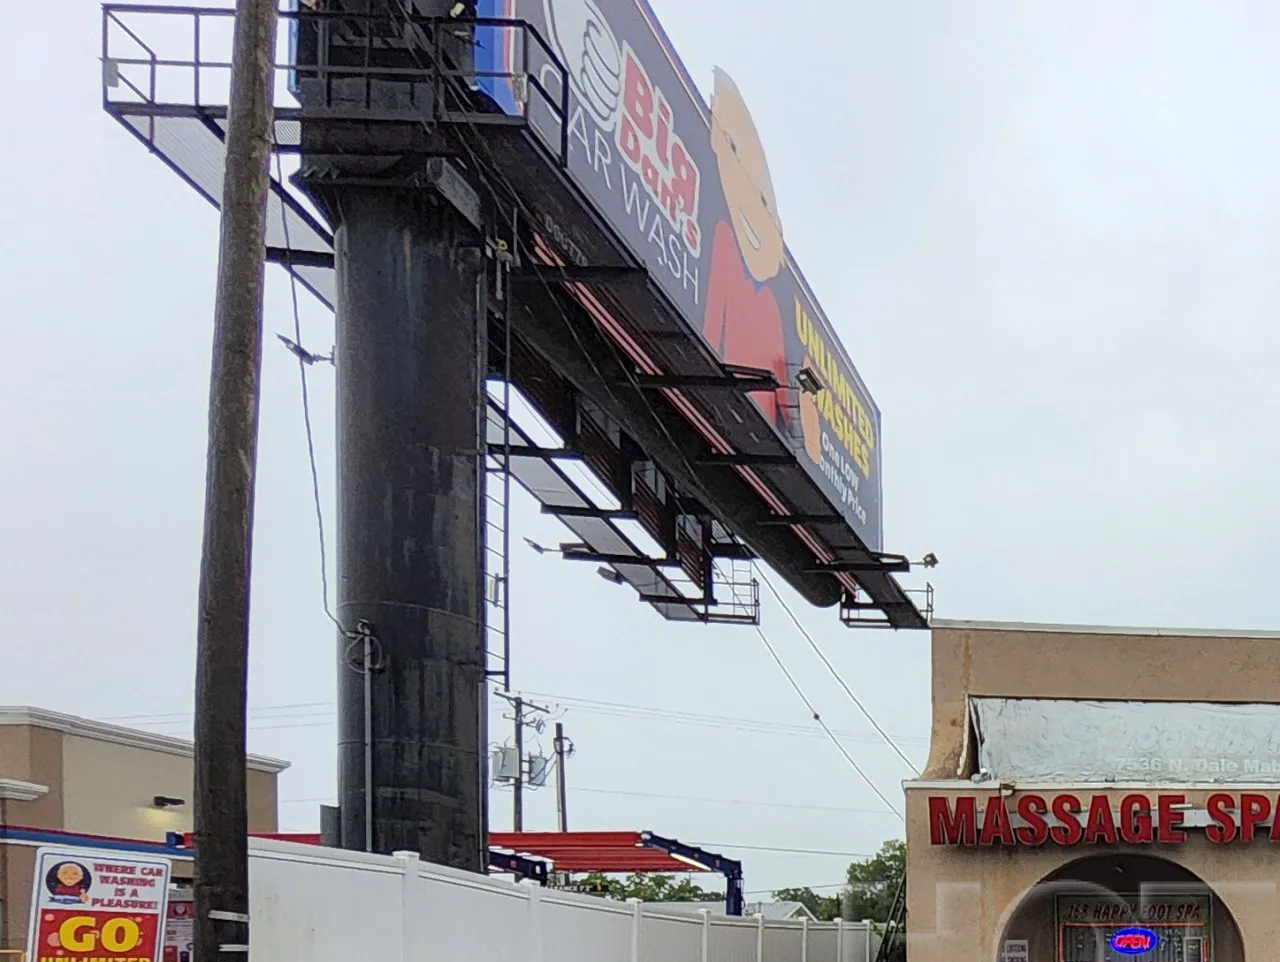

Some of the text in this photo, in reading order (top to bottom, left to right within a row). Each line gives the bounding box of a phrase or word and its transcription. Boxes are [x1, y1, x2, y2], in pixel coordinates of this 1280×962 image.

[622, 54, 697, 217] Big
[540, 63, 612, 189] CAR
[620, 164, 698, 304] WASH
[794, 293, 875, 449] UNLIMITED
[820, 455, 848, 503] onthly
[928, 794, 1187, 846] MASSAGE
[130, 889, 139, 897] A
[59, 916, 140, 953] GO
[1116, 934, 1151, 949] OPEN
